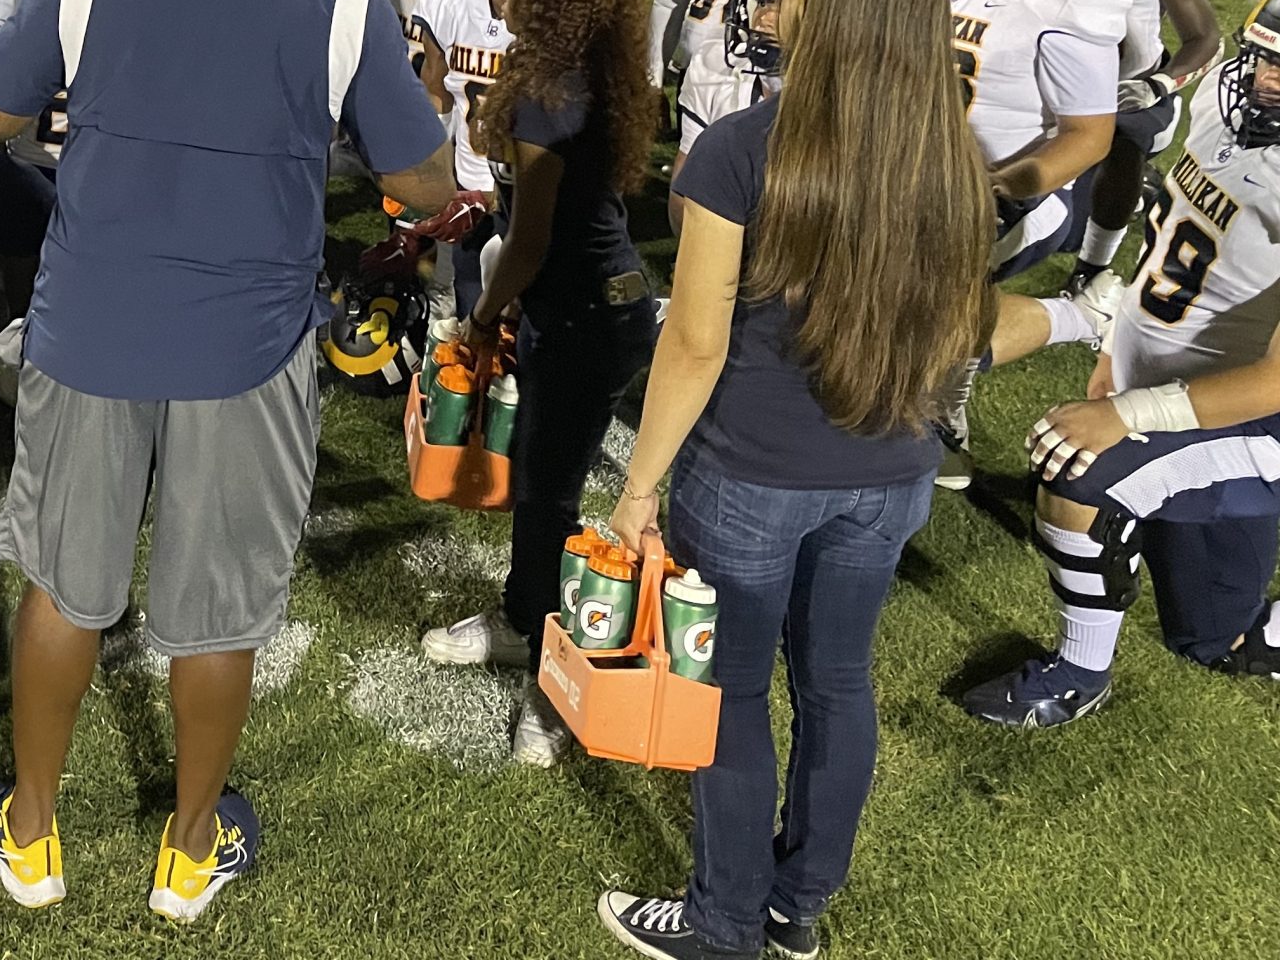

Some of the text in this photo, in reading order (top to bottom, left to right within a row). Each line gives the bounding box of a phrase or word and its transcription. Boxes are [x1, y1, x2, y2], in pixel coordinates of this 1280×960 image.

[1172, 152, 1239, 232] MILLIKAN
[579, 601, 613, 640] G
[683, 622, 715, 662] G
